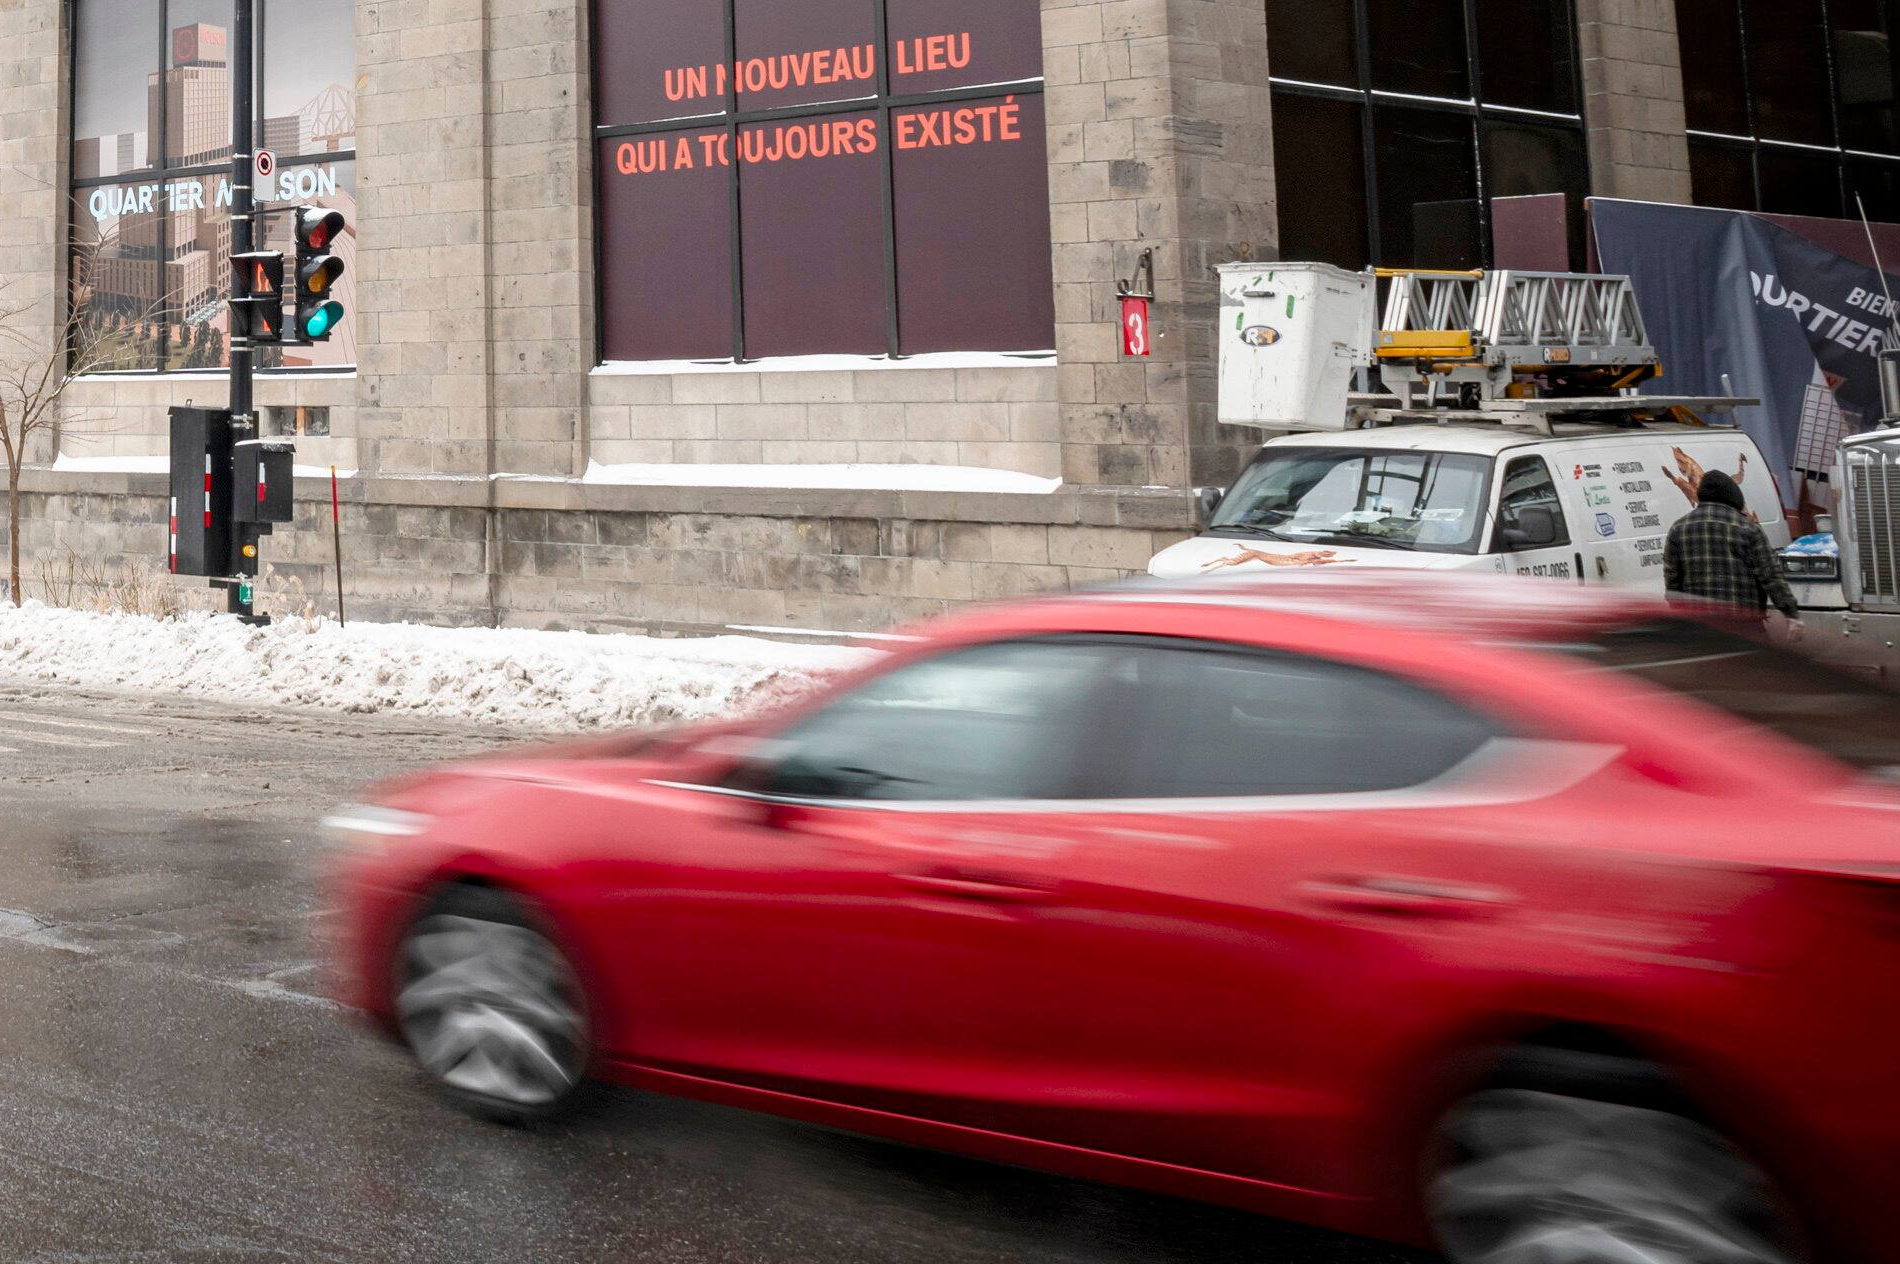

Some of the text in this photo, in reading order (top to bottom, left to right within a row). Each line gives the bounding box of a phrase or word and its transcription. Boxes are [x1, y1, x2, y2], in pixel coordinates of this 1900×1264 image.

[663, 32, 970, 101] UN NOUVEAU LIEU
[616, 95, 1021, 175] QUI A TOUJOURS EXISTÉ
[214, 166, 336, 208] MSON
[1128, 312, 1145, 356] 3
